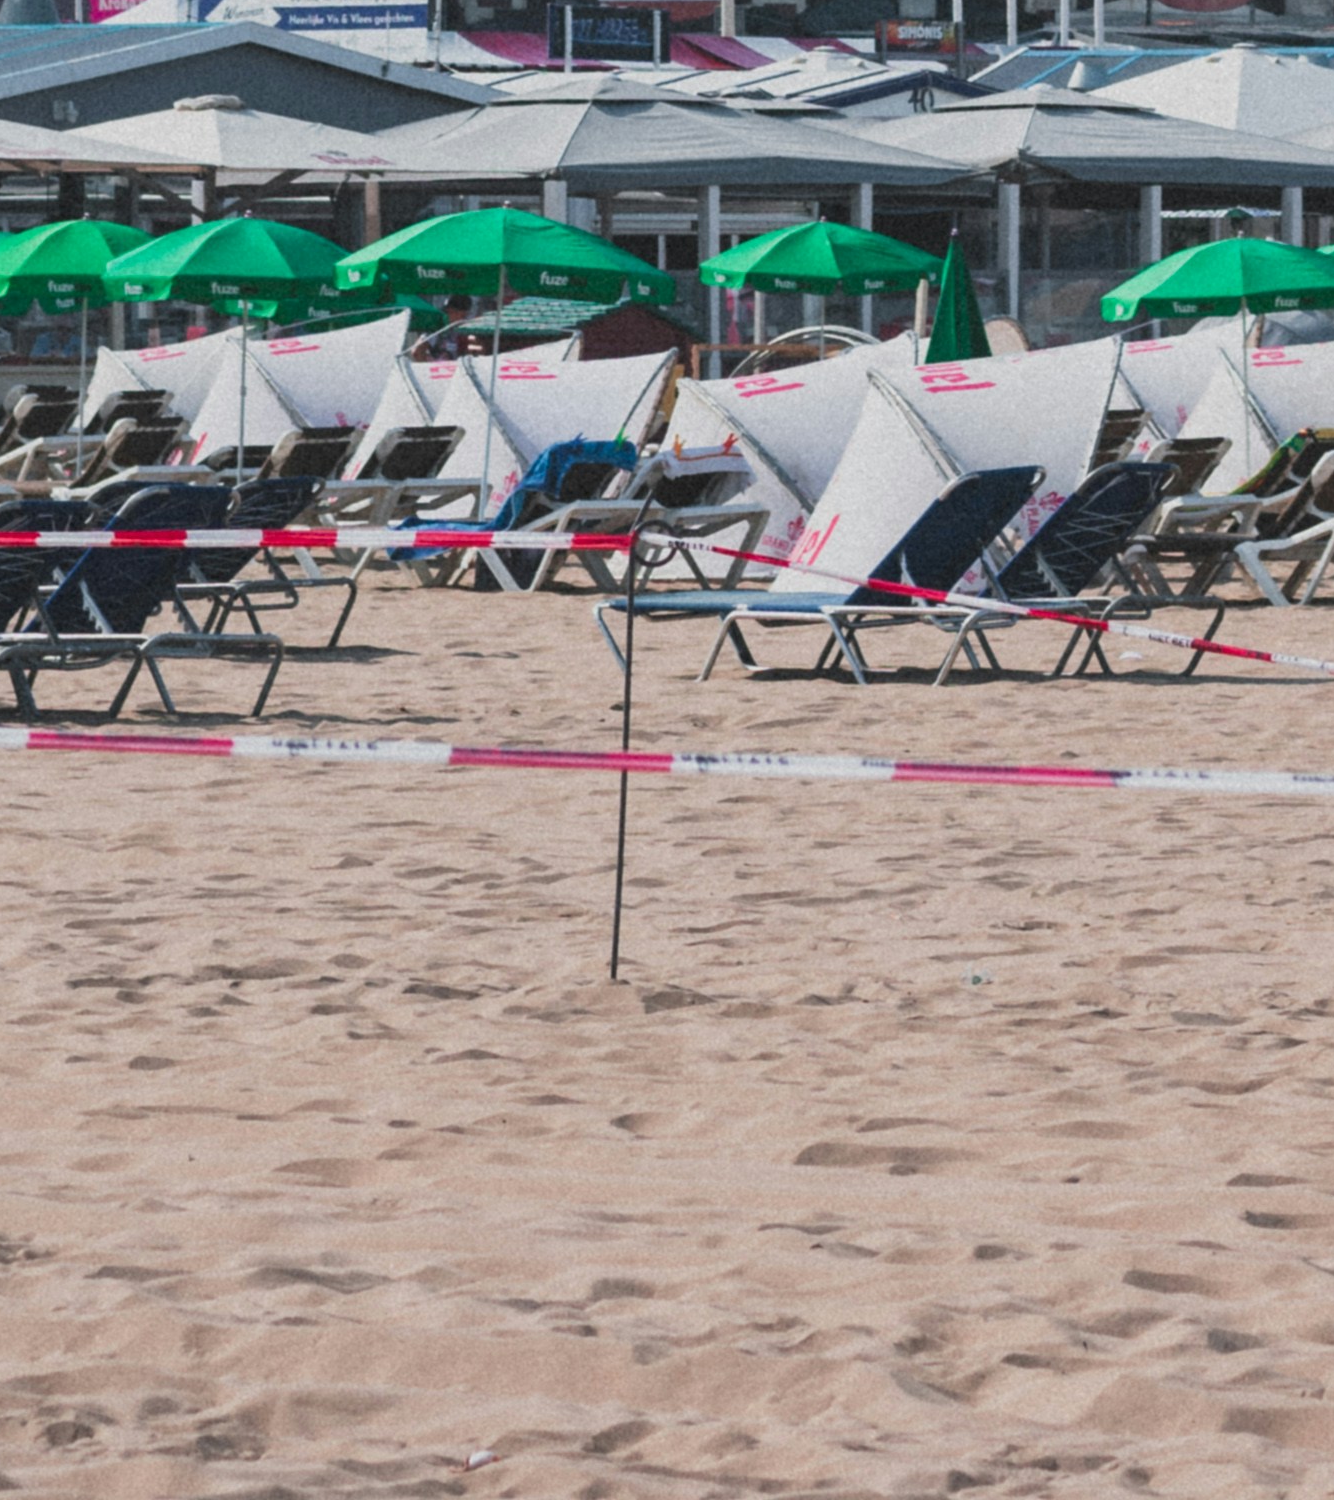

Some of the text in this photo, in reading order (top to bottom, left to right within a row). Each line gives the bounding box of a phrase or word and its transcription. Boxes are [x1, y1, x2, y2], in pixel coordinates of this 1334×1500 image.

[417, 265, 445, 279] fuze
[540, 271, 568, 286] fuze
[48, 280, 74, 292] fuze
[211, 282, 240, 294] fuze
